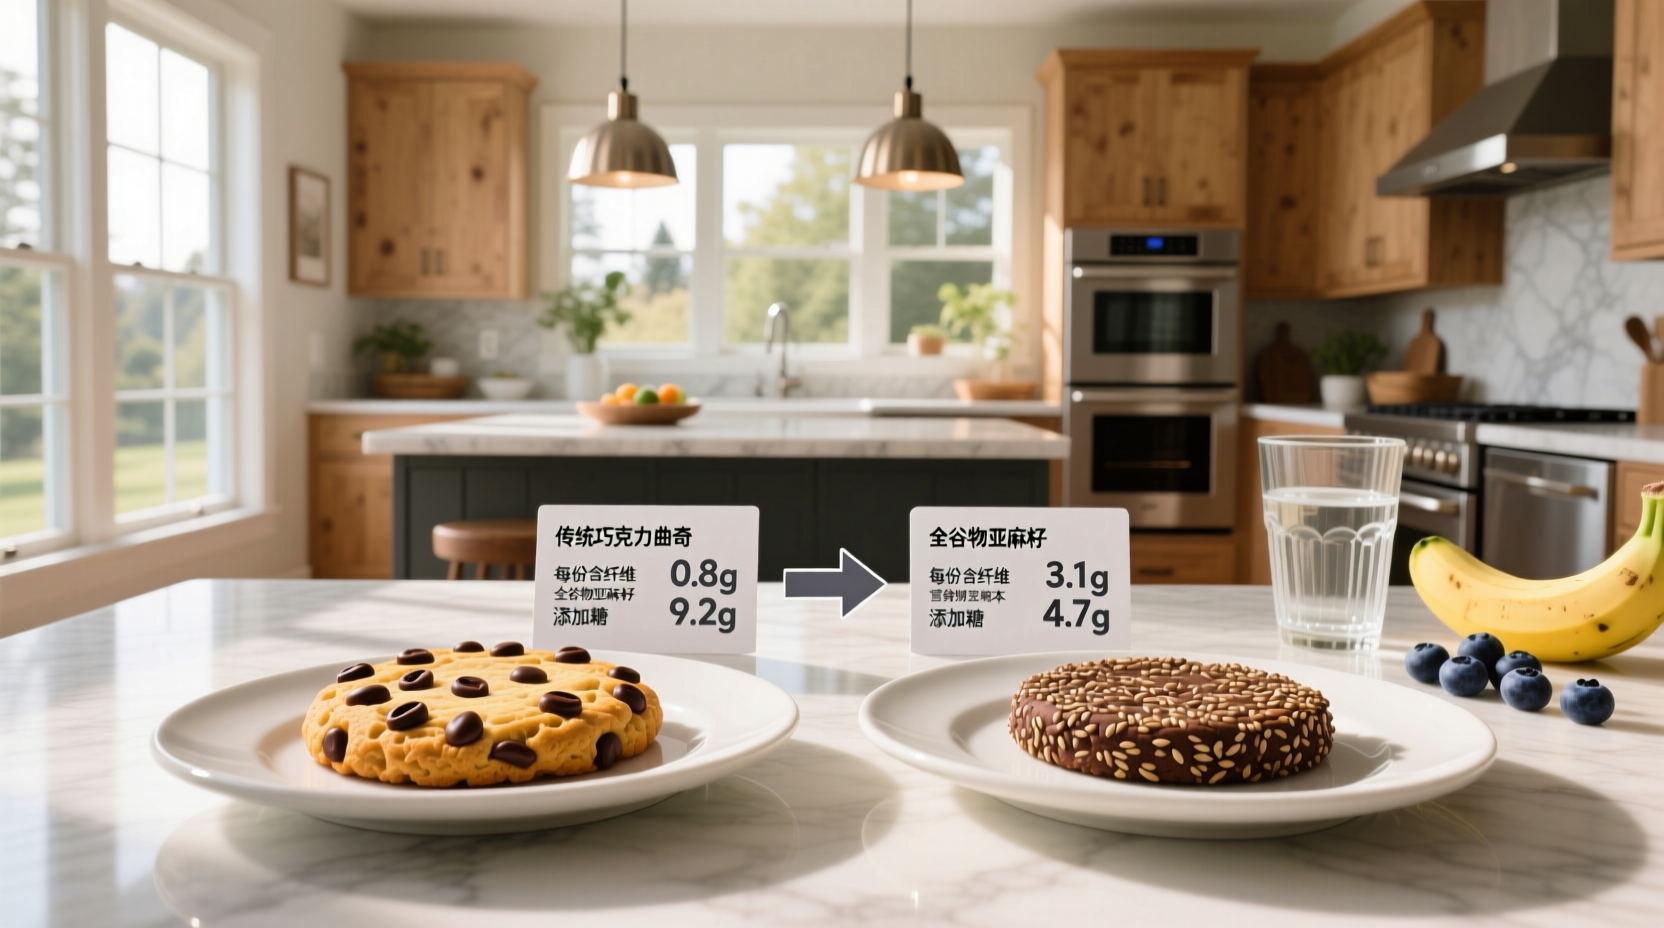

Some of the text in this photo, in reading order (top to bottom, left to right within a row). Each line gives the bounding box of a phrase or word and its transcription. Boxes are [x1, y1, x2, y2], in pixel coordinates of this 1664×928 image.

[555, 525, 692, 547] 传统巧克力曲奇
[554, 559, 737, 595] 每份含纤维 0.8g
[929, 561, 1108, 596] 每份含纤维 3.1g
[553, 597, 736, 633] 添加糖 9.2g
[929, 599, 1109, 636] 添加糖 4.7g
